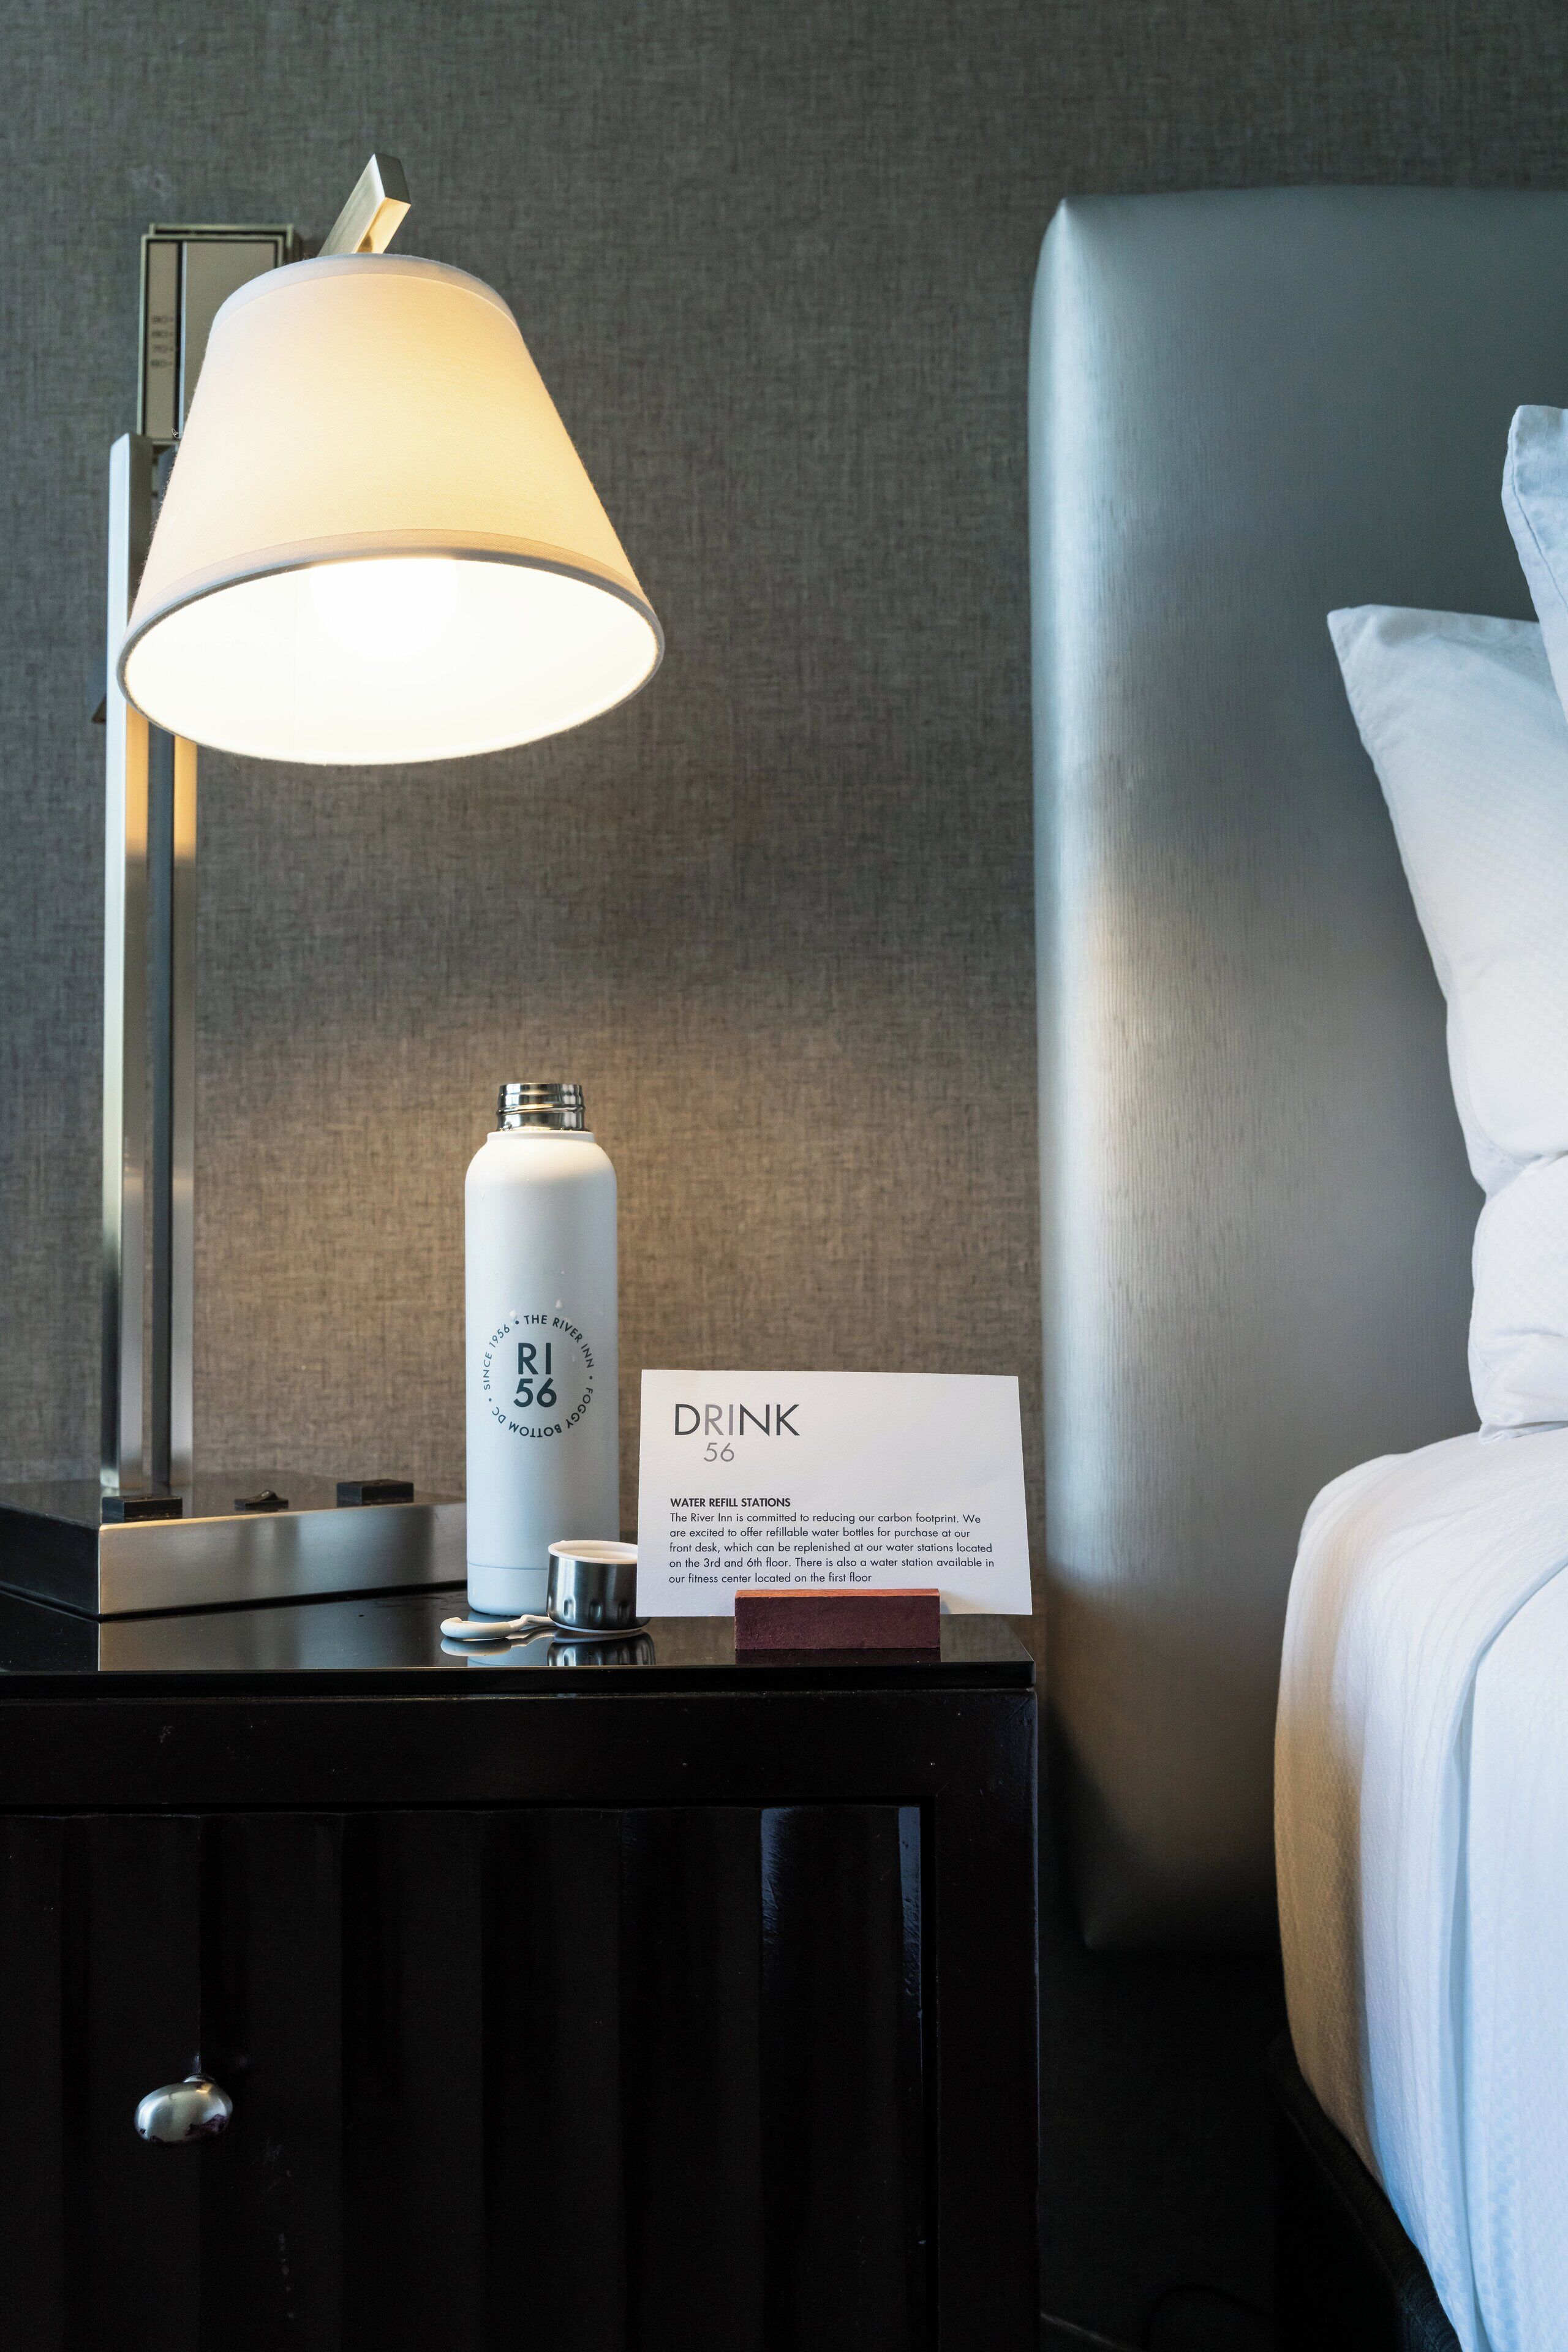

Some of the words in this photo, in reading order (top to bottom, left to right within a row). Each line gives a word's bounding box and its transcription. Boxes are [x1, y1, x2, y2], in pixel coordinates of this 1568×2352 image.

[524, 1314, 548, 1325] THE
[552, 1317, 582, 1343] RIVER
[581, 1343, 594, 1368] INN
[483, 1351, 492, 1390] SINCE
[489, 1324, 510, 1348] 1956
[518, 1342, 551, 1375] RI
[513, 1378, 557, 1408] 56
[491, 1406, 507, 1424] DC
[565, 1387, 593, 1429] FOGGY
[674, 1403, 801, 1437] DRINK
[508, 1421, 562, 1438] BOTTOM
[703, 1442, 735, 1463] 56
[669, 1498, 706, 1507] WATER
[709, 1498, 739, 1507] REFILL
[741, 1497, 791, 1507] STATIONS
[669, 1512, 687, 1523] The
[690, 1512, 715, 1522] River
[718, 1512, 733, 1522] Inn
[736, 1513, 744, 1522] is
[746, 1512, 797, 1522] committed
[799, 1513, 810, 1522] to
[812, 1512, 856, 1525] reducing
[878, 1512, 913, 1523] carbon
[916, 1512, 959, 1526] footprint.
[962, 1513, 981, 1524] We
[689, 1526, 725, 1537] excited
[727, 1529, 737, 1537] to
[740, 1526, 763, 1537] offer
[766, 1526, 809, 1537] refillable
[811, 1528, 840, 1537] water
[843, 1526, 875, 1537] bottles
[877, 1526, 892, 1537] for
[894, 1527, 939, 1540] purchase
[941, 1529, 952, 1537] at
[669, 1542, 693, 1553] front
[695, 1542, 720, 1554] desk,
[723, 1542, 753, 1553] which
[778, 1541, 791, 1552] be
[794, 1541, 851, 1555] replenished
[854, 1543, 864, 1551] at
[886, 1544, 914, 1552] water
[917, 1543, 954, 1552] stations
[956, 1542, 992, 1553] located
[685, 1557, 700, 1568] the
[703, 1556, 721, 1568] 3rd
[723, 1556, 744, 1567] and
[746, 1556, 763, 1567] 6th
[766, 1556, 791, 1567] floor.
[794, 1556, 823, 1567] There
[826, 1558, 834, 1567] is
[836, 1556, 857, 1567] also
[870, 1558, 899, 1567] water
[901, 1558, 933, 1567] station
[937, 1556, 982, 1567] available
[986, 1558, 994, 1567] in
[688, 1572, 718, 1583] fitness
[721, 1574, 752, 1583] center
[755, 1572, 791, 1583] located
[810, 1572, 826, 1583] the
[828, 1571, 846, 1582] first
[849, 1571, 872, 1582] floor
